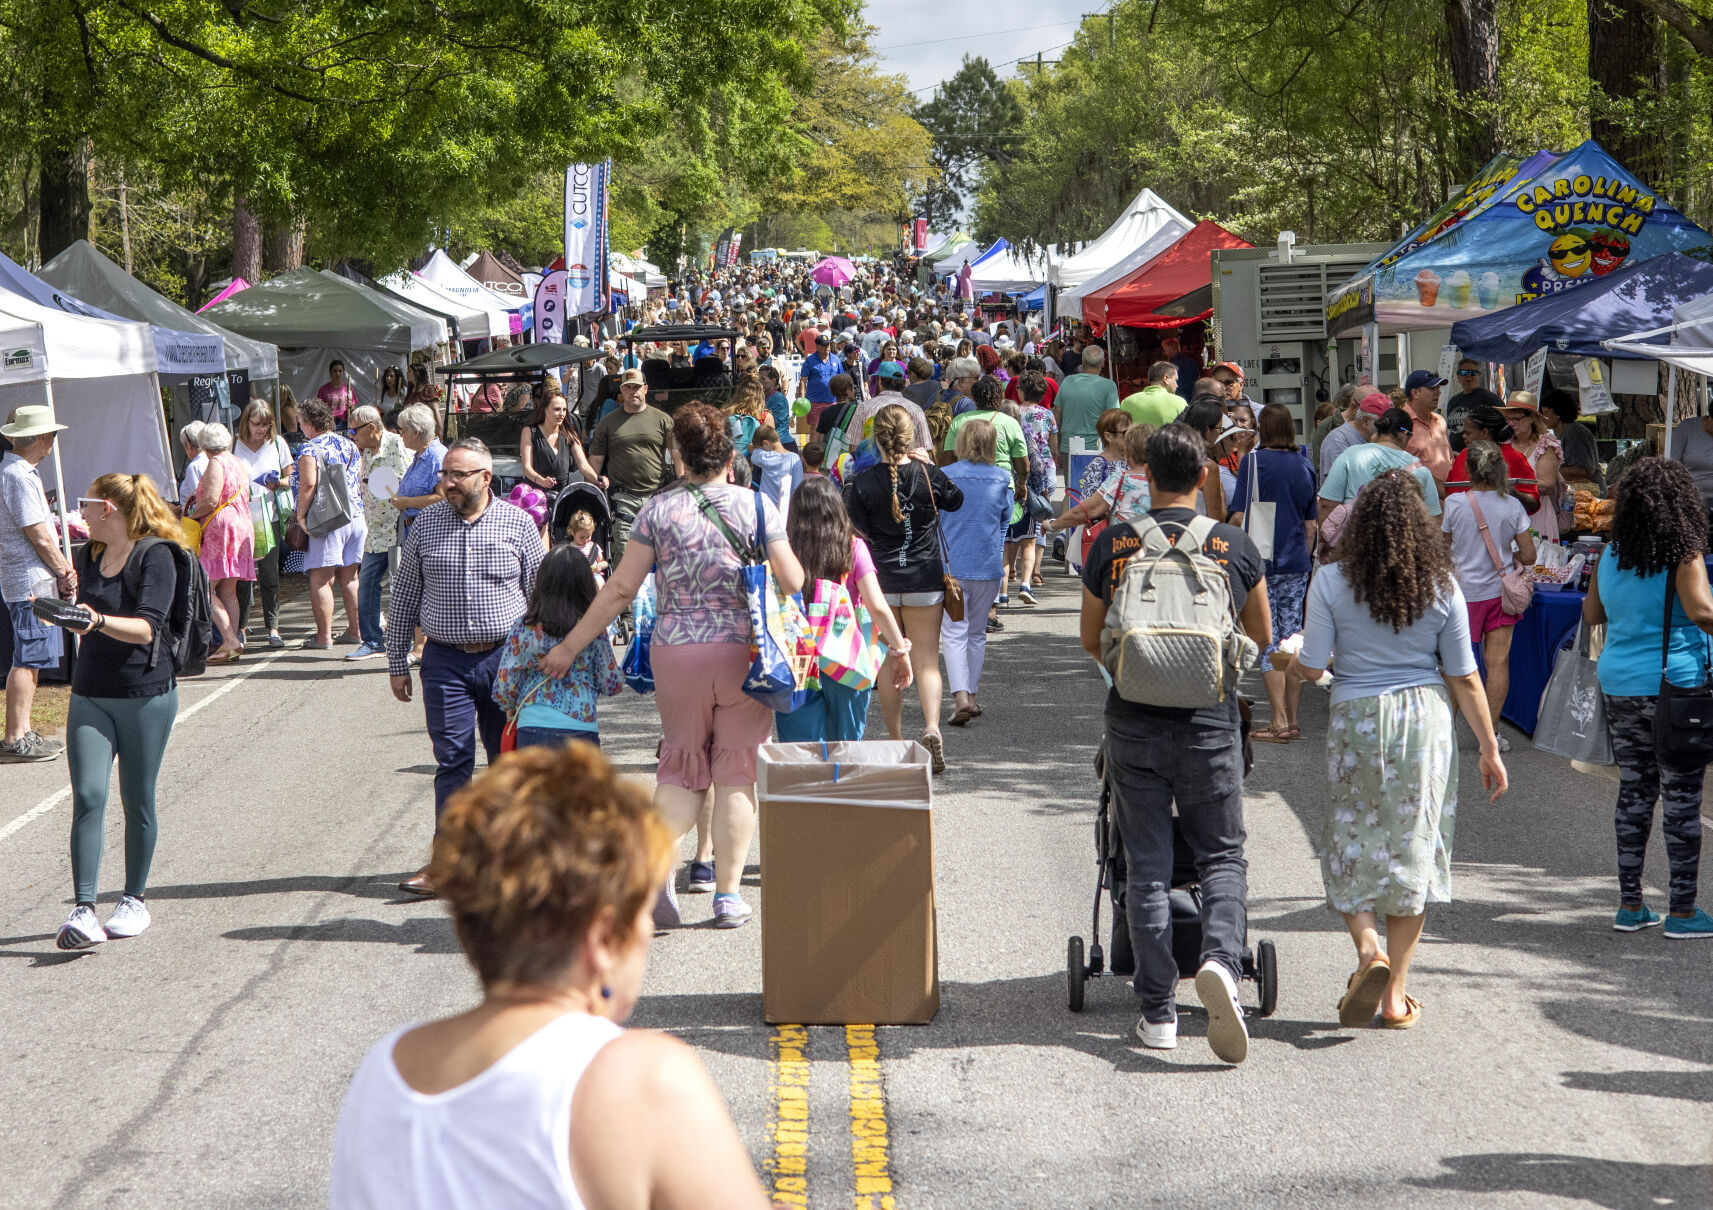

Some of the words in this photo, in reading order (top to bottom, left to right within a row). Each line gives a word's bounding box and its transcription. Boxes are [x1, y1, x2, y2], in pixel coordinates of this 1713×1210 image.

[572, 161, 589, 215] CUTCO
[1516, 175, 1656, 216] CAROLINA
[1534, 201, 1646, 236] QUENCH
[483, 281, 523, 292] TCO
[193, 375, 229, 389] Regist
[230, 374, 243, 384] To
[1211, 536, 1230, 554] the
